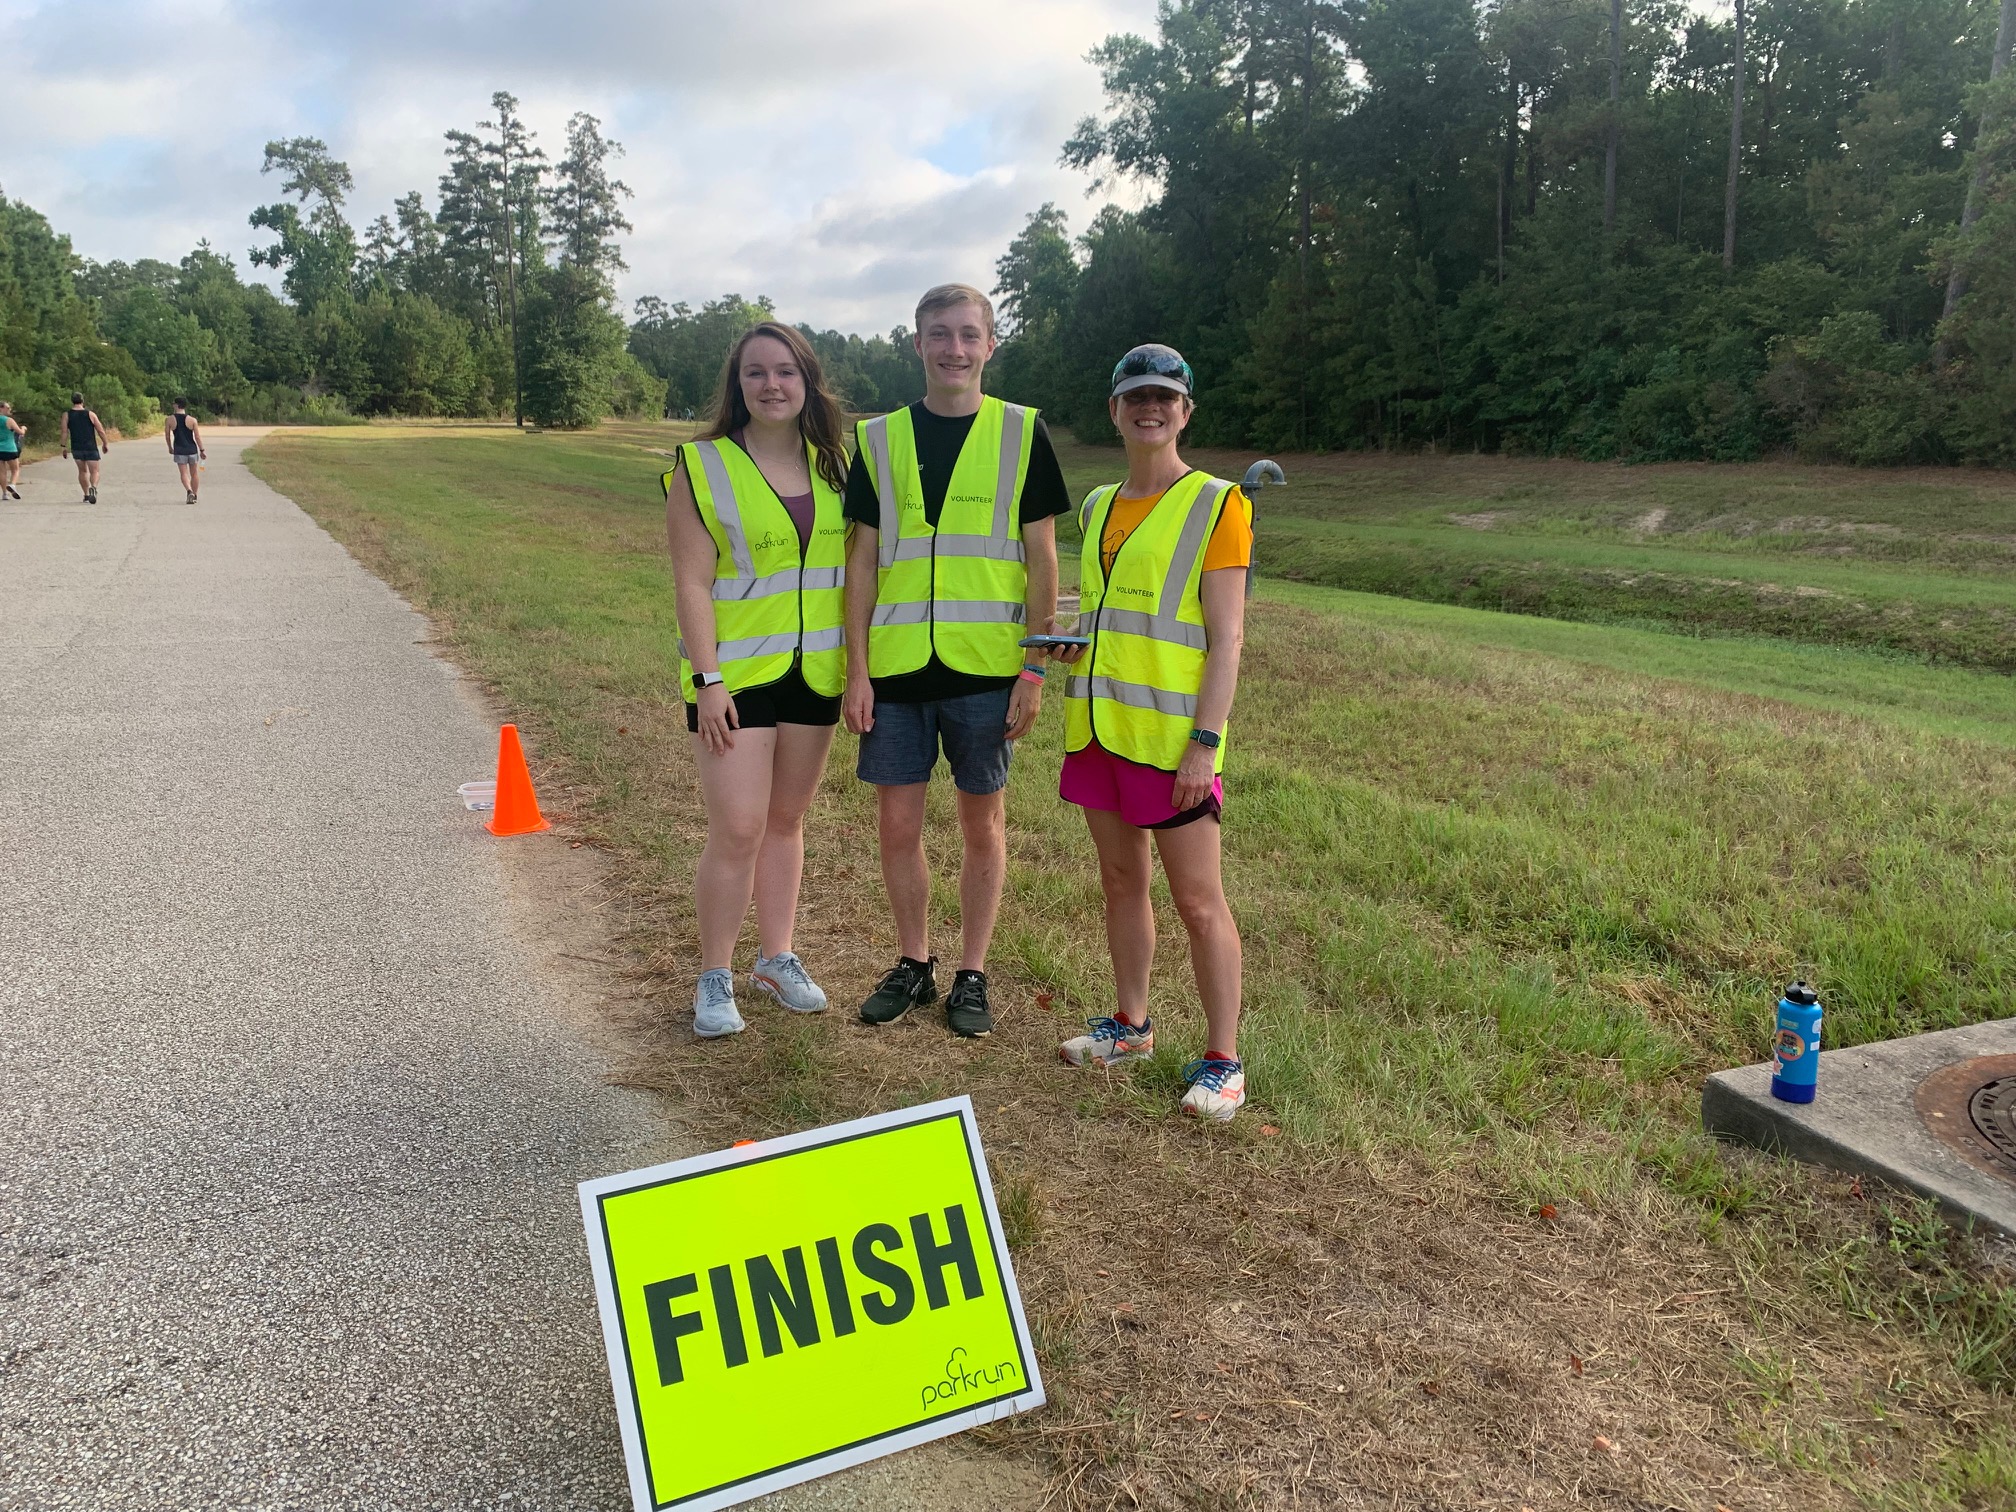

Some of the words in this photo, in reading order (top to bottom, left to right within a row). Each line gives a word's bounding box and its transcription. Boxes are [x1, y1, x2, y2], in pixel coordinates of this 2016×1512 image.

[755, 532, 788, 551] parkrun
[1116, 586, 1154, 598] VOLUNTEER
[643, 1204, 985, 1388] FINISH
[921, 1348, 1016, 1411] parkrun
